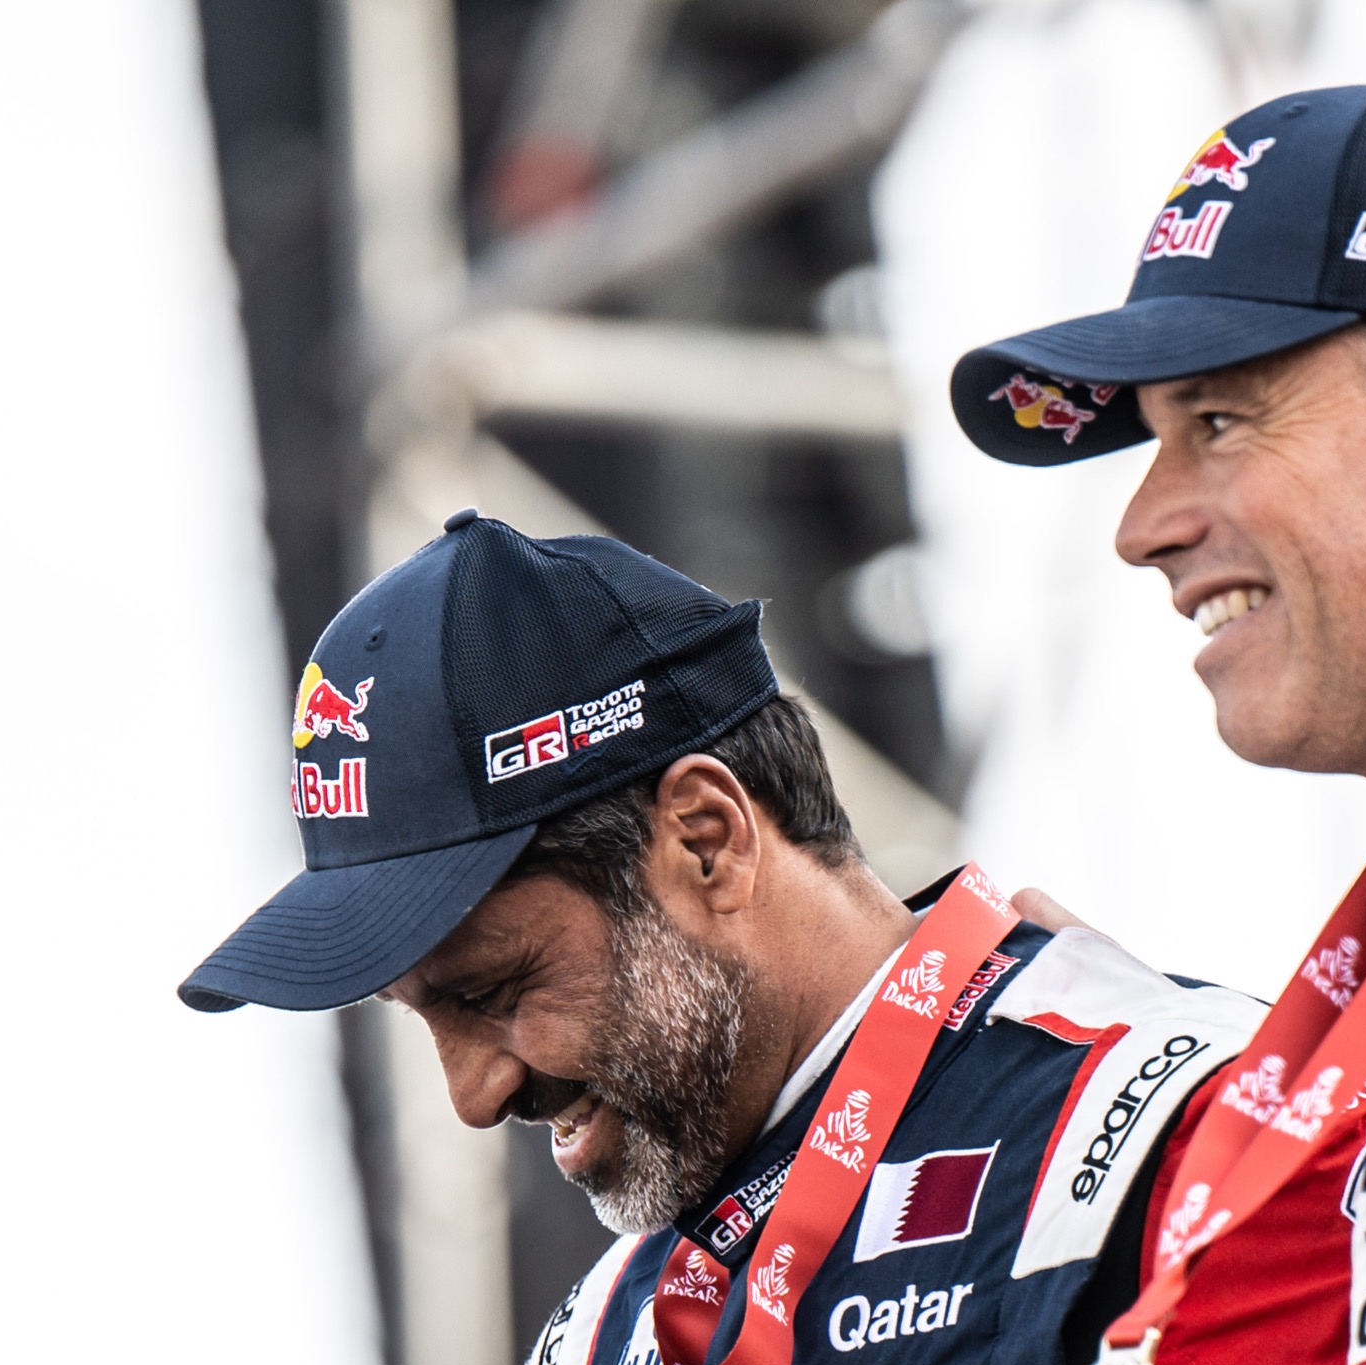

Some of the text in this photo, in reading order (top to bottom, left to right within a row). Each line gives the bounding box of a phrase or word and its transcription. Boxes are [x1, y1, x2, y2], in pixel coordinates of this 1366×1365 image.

[1144, 203, 1226, 257] Bull
[564, 679, 646, 721] TOYOTA
[569, 696, 643, 735] GAZOO
[571, 711, 645, 750] Racing
[490, 730, 565, 777] GR
[300, 760, 366, 816] Bull
[960, 873, 1012, 919] DAKAR
[881, 980, 939, 1019] DAKAR
[809, 1125, 866, 1175] DAKAR
[710, 1210, 753, 1251] GR
[662, 1283, 721, 1307] DAKAR
[828, 1282, 975, 1352] Qatar
